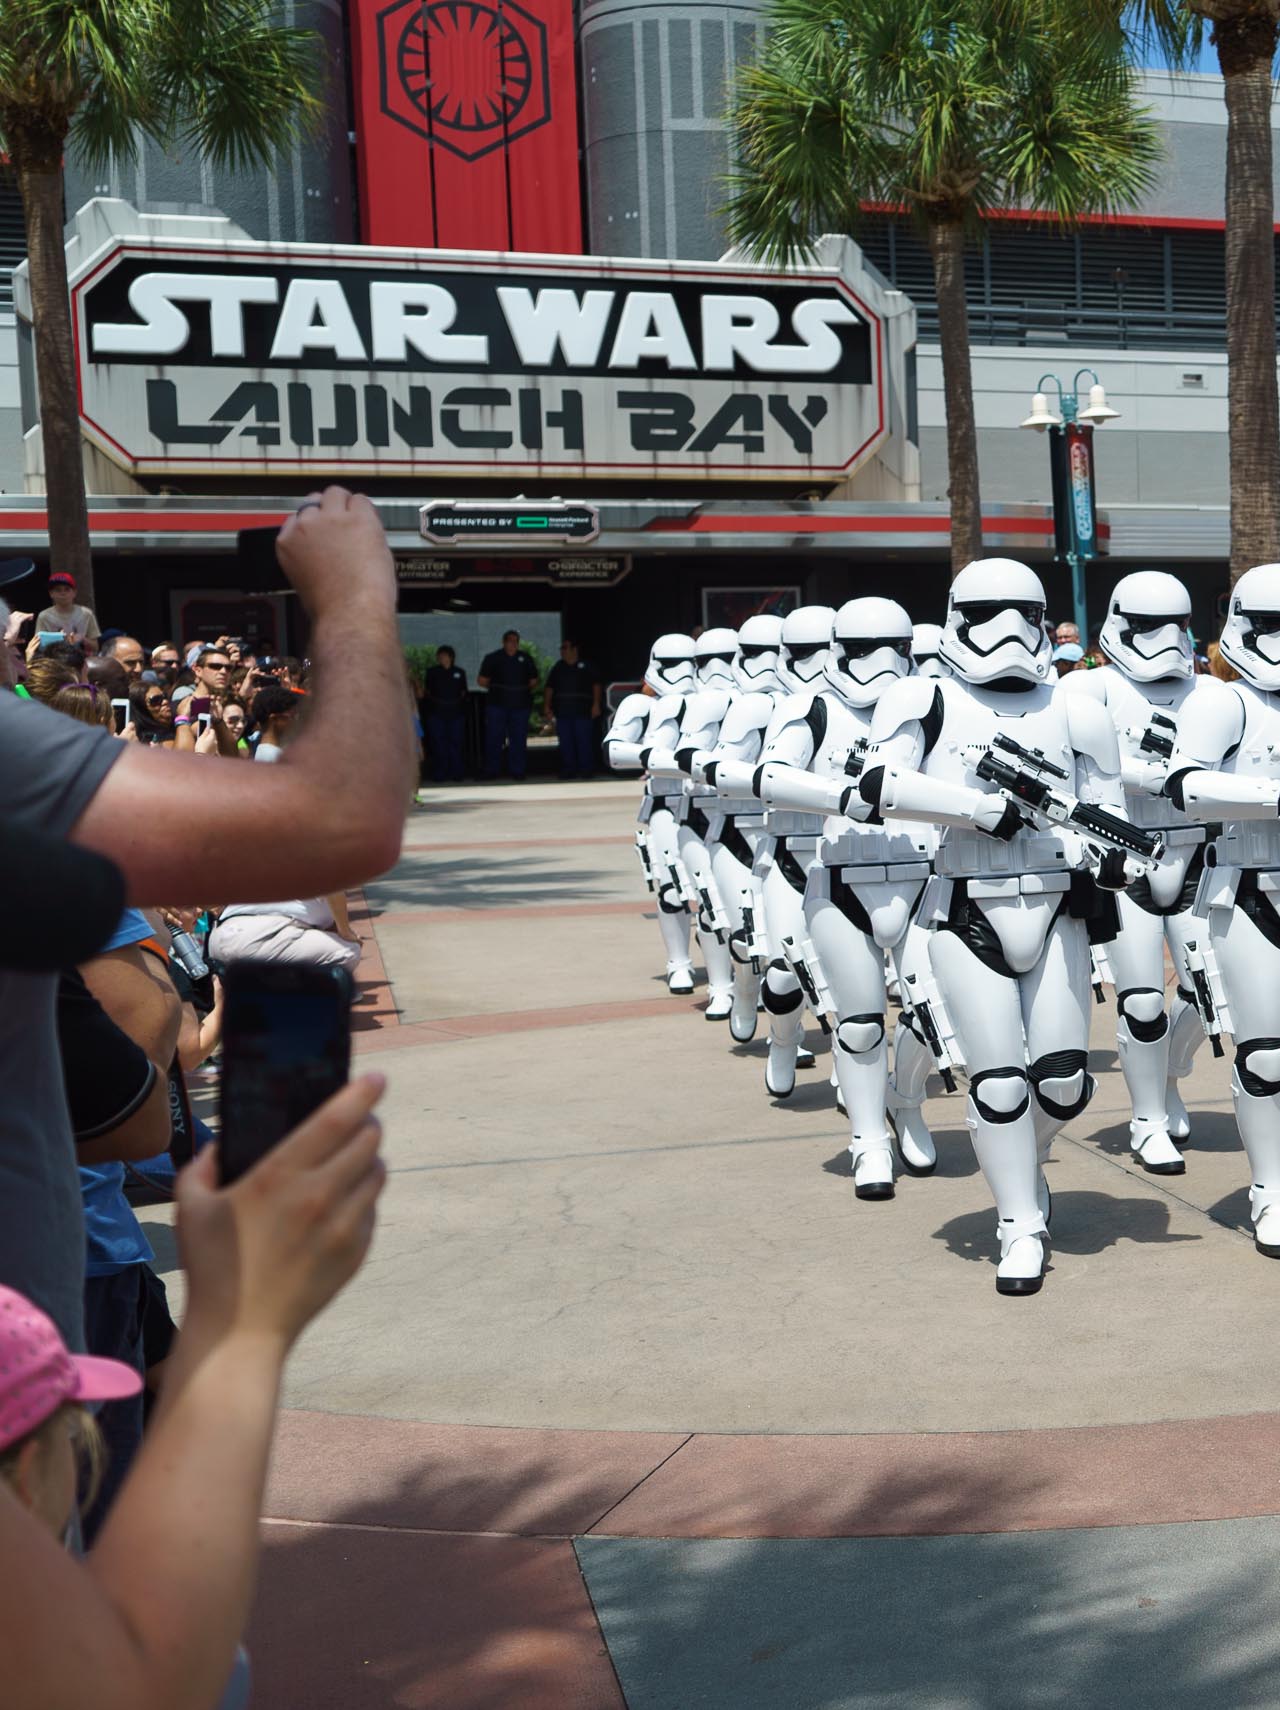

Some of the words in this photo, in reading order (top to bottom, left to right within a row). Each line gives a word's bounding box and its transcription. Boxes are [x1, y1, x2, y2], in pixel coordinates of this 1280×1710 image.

[91, 272, 491, 365] STAR
[496, 286, 864, 373] WARS
[146, 378, 585, 450] LAUNCH
[617, 390, 829, 455] BAY
[432, 517, 496, 527] PRESENTED
[498, 517, 513, 527] BY
[548, 561, 618, 570] CHARACTER
[168, 1081, 185, 1134] SONY
